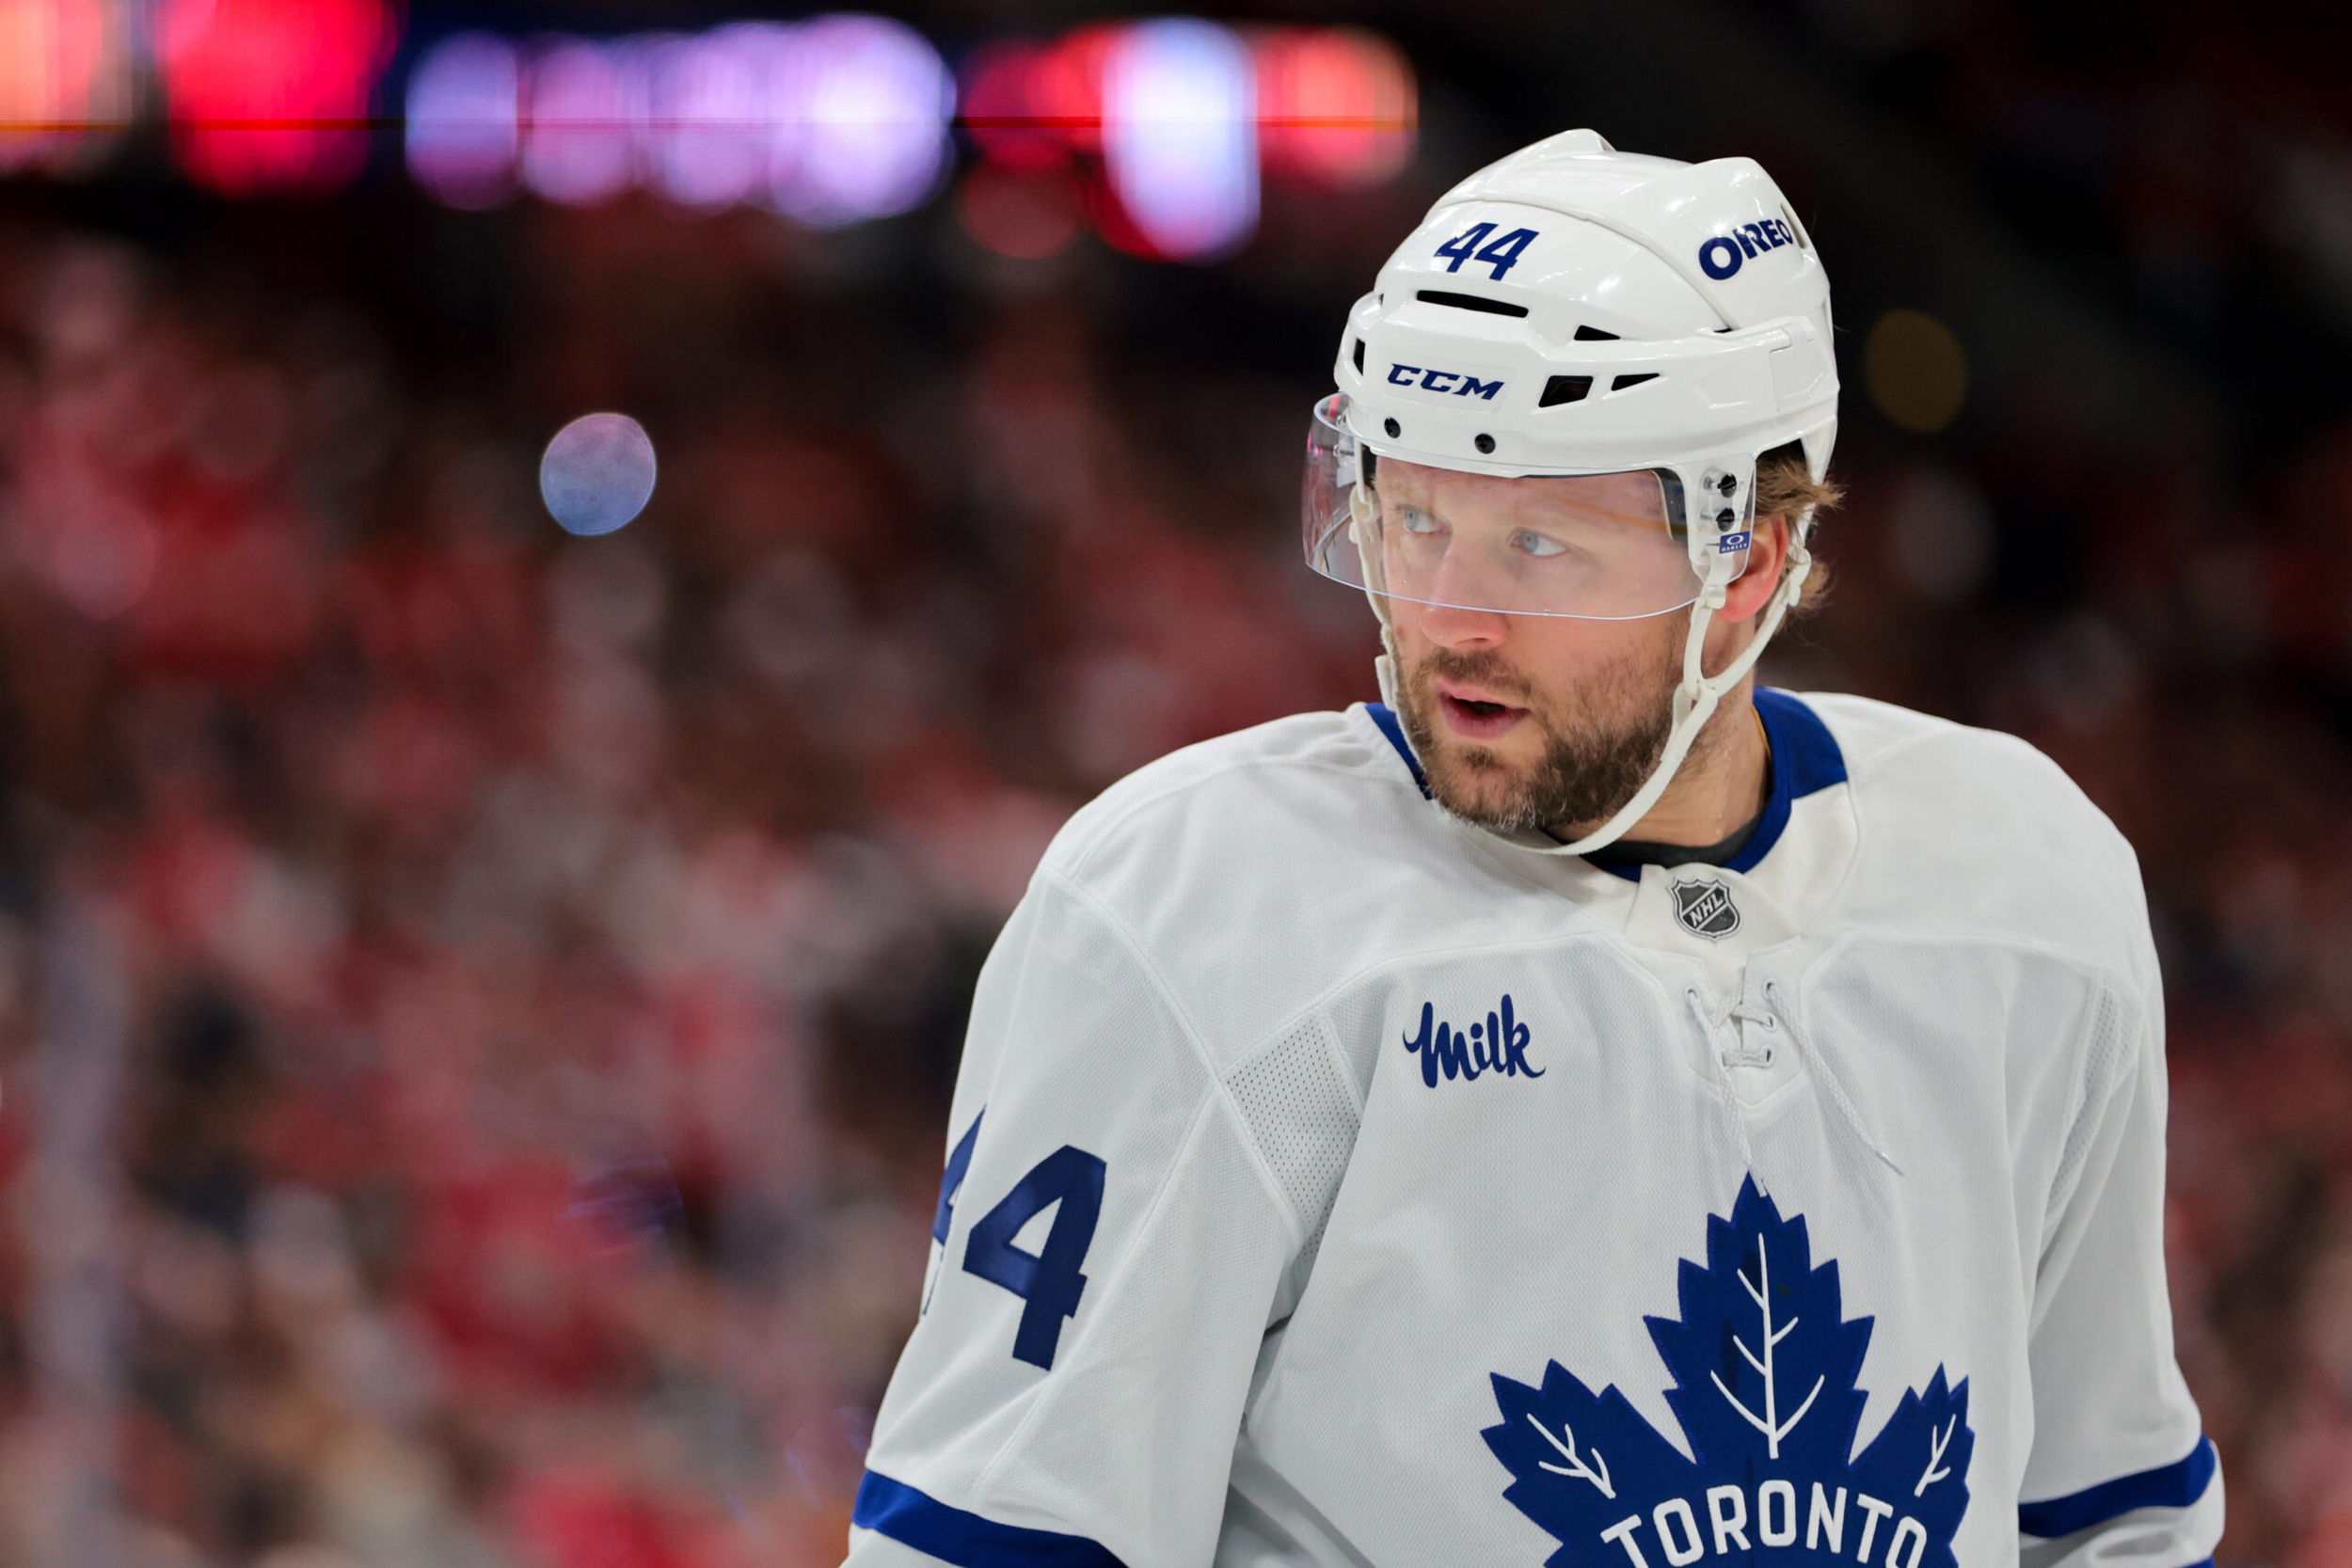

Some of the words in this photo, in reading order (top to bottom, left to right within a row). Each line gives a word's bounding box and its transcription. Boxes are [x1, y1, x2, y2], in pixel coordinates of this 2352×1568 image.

[1434, 222, 1539, 281] 44
[1698, 218, 1793, 280] OREO
[1387, 362, 1505, 401] CCM
[1689, 893, 1724, 927] NHL
[1403, 993, 1547, 1088] Milk
[1599, 1480, 1928, 1568] TORONTO
